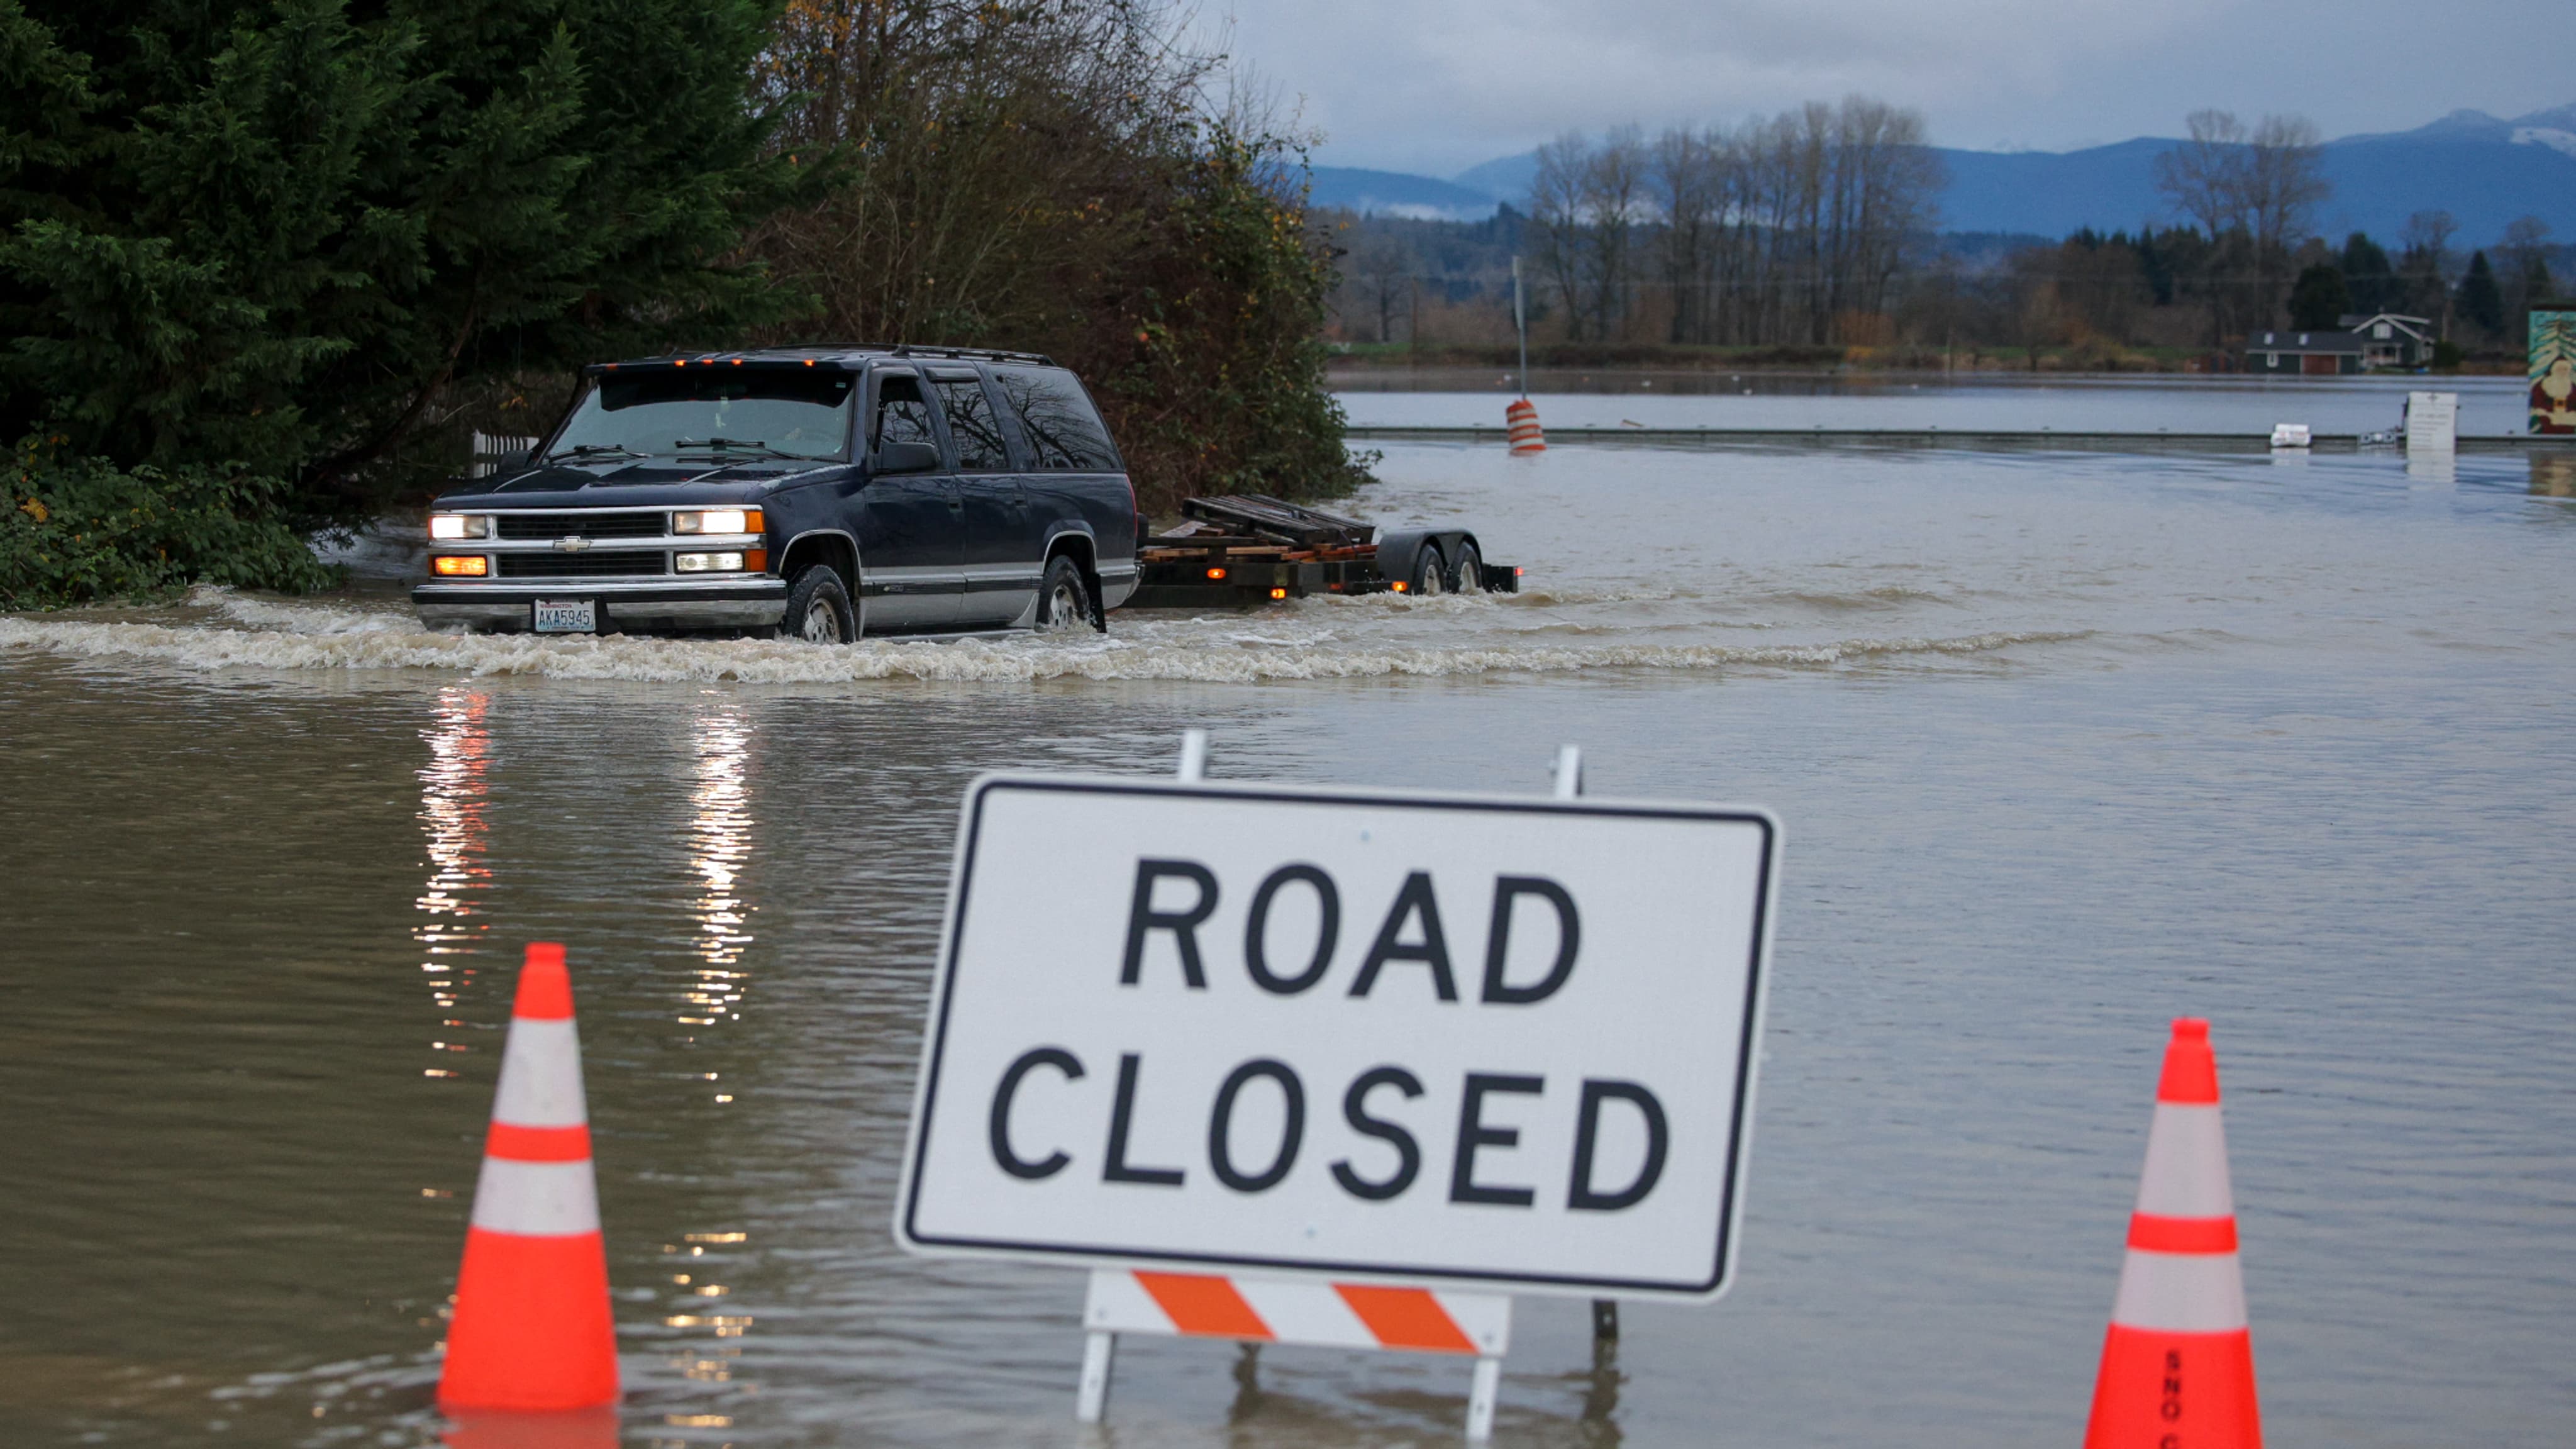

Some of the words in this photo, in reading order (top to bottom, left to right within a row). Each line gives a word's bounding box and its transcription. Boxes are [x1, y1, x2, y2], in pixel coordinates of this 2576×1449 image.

[539, 610, 590, 626] AKA5945
[1119, 857, 1581, 1006] ROAD
[989, 1046, 1670, 1213] CLOSED
